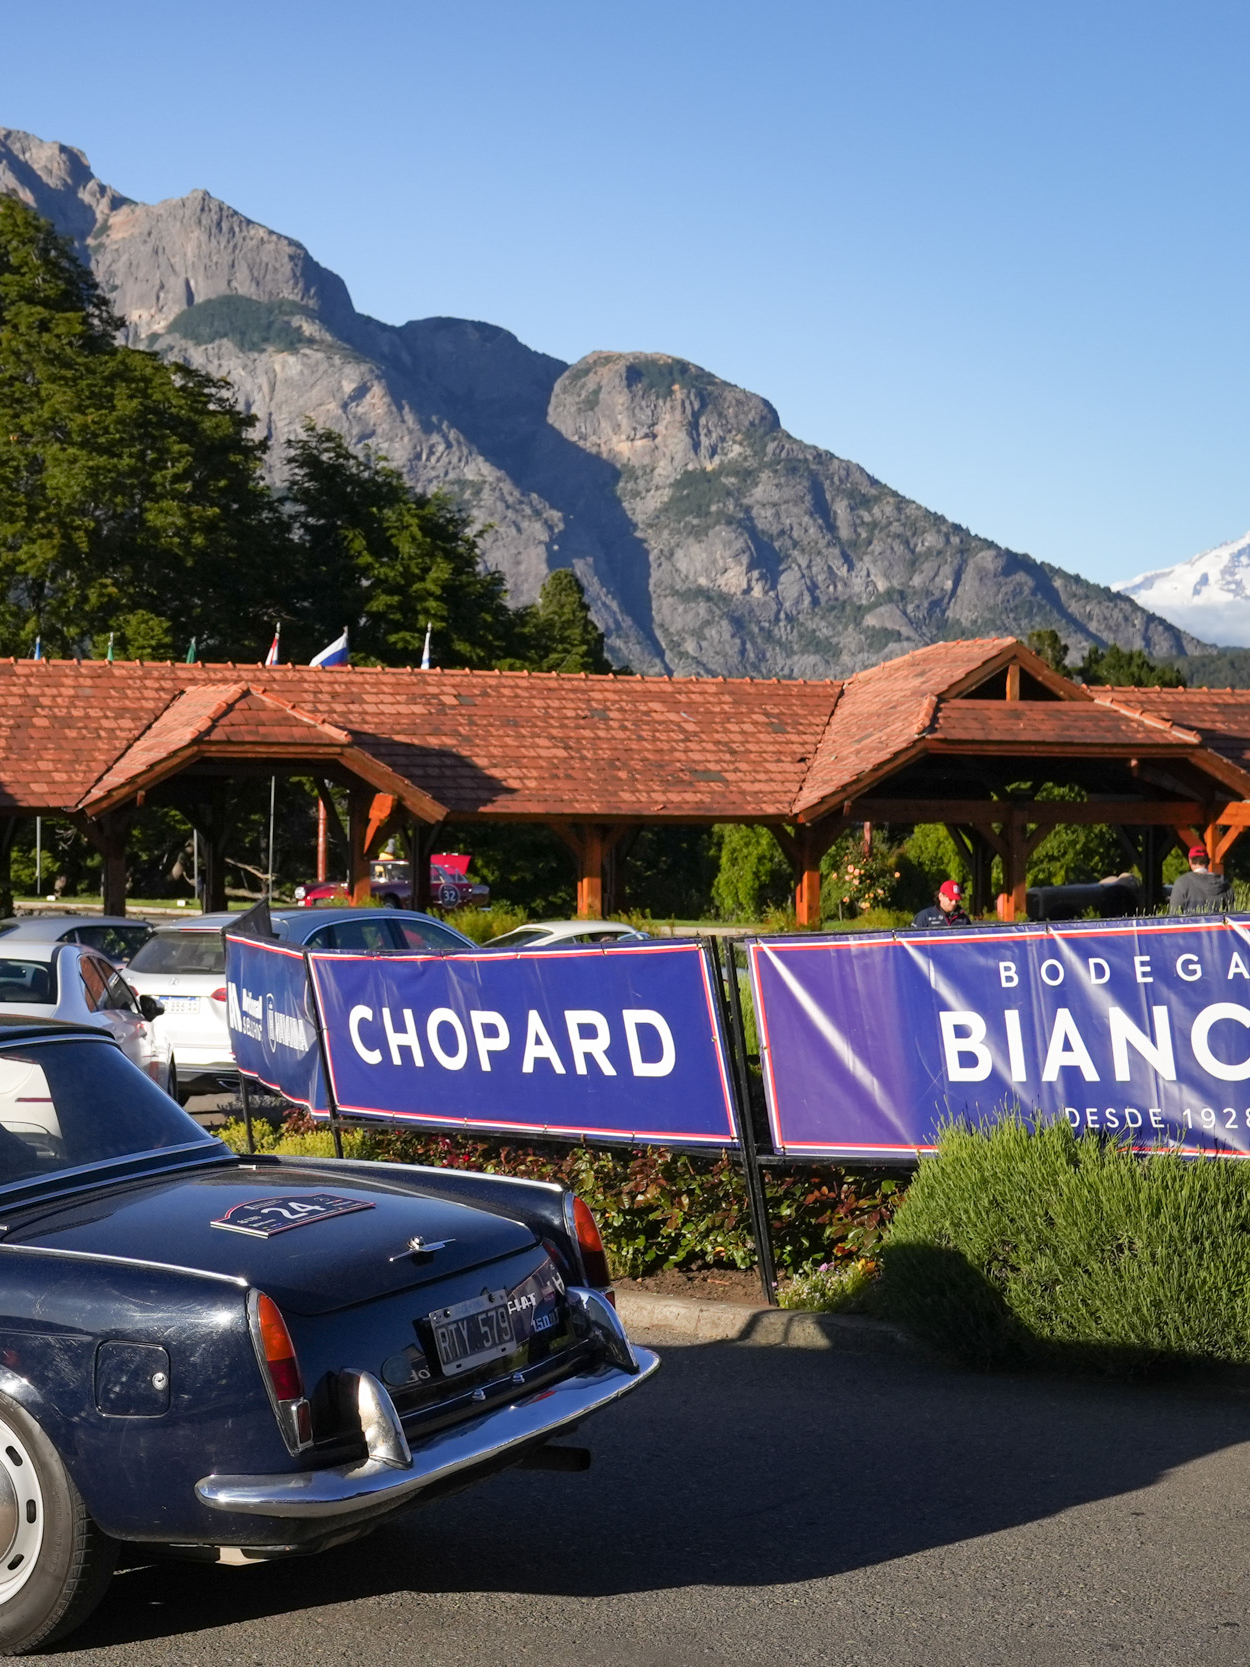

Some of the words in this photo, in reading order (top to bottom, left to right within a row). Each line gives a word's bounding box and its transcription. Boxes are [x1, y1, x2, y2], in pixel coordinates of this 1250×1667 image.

[443, 890, 456, 902] 32
[999, 951, 1250, 988] BODEGA
[349, 1004, 676, 1078] CHOPARD
[1065, 1107, 1166, 1129] DESDE
[261, 1202, 326, 1220] 24
[507, 1292, 537, 1315] FIAT
[438, 1319, 471, 1363] RTY
[478, 1307, 511, 1348] 579
